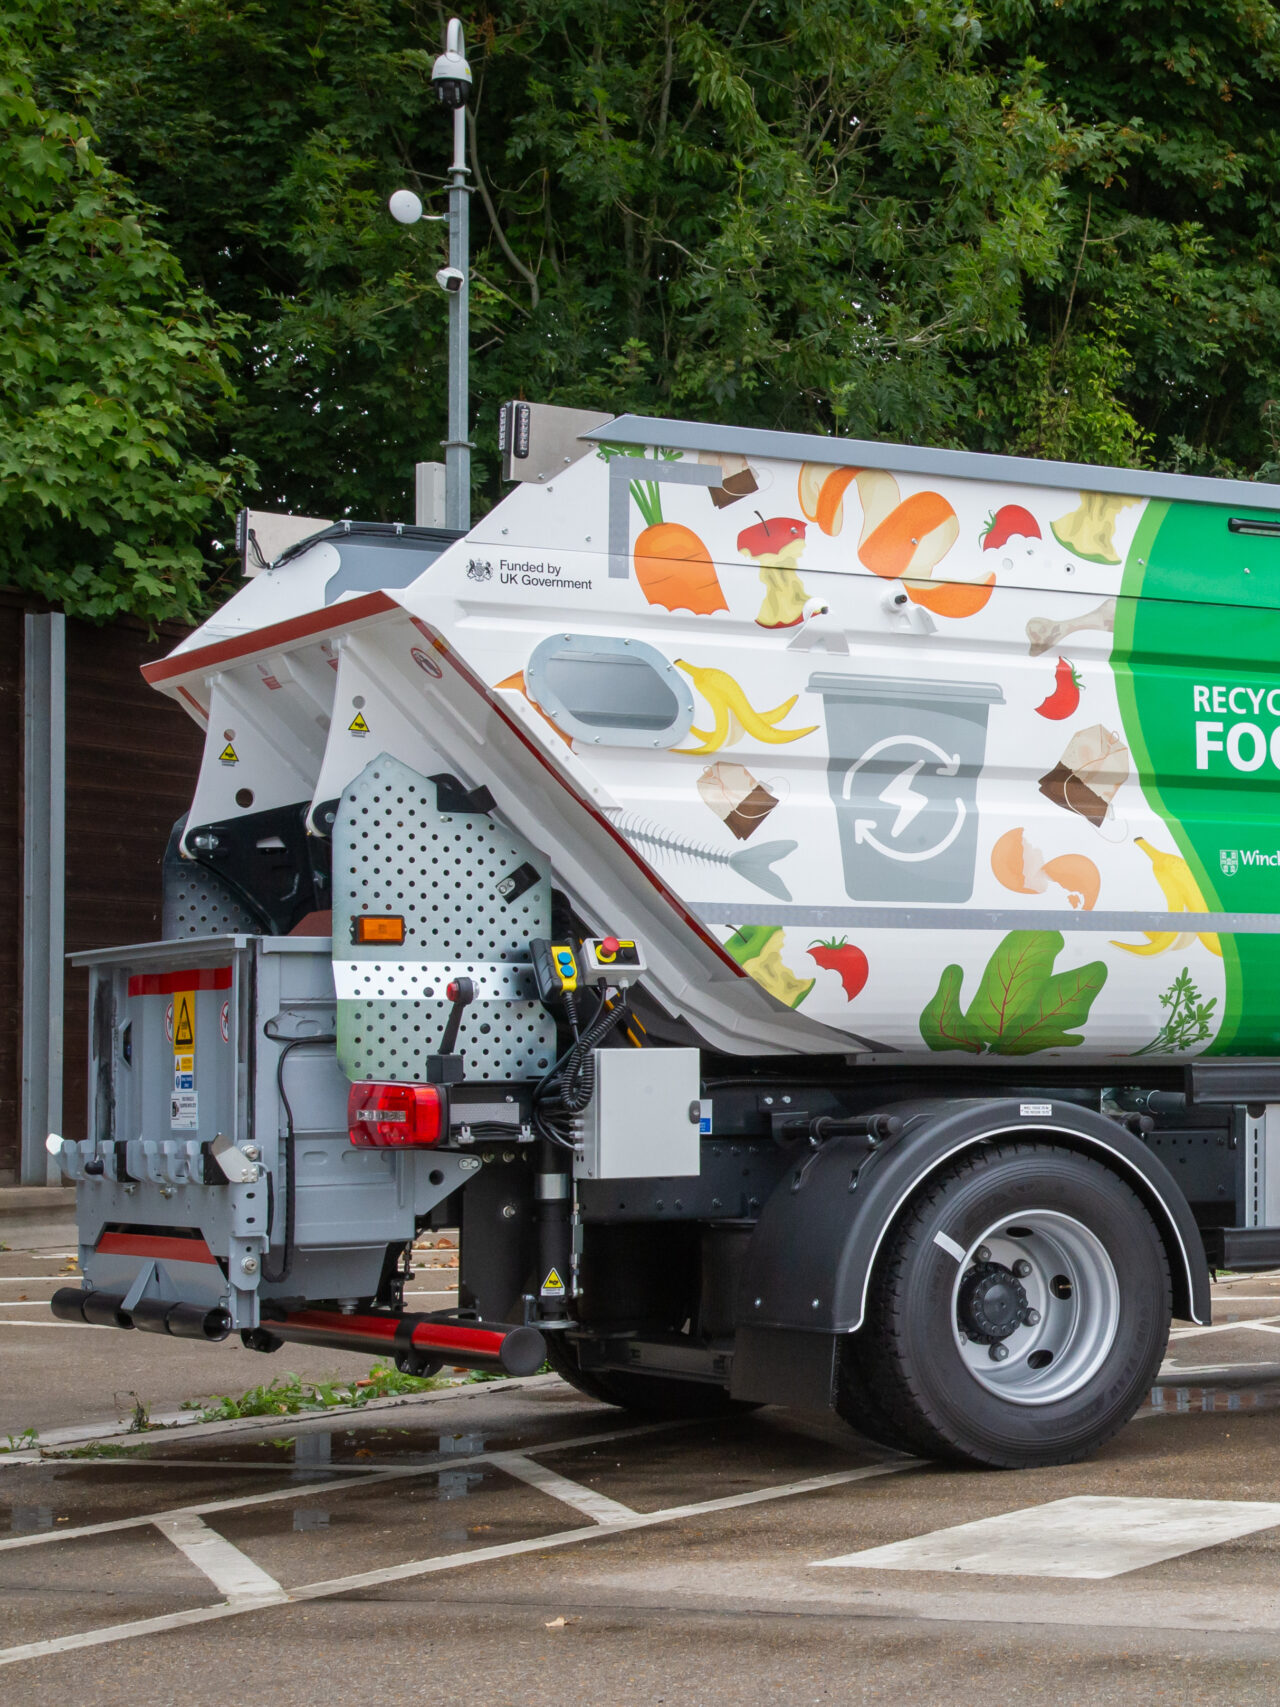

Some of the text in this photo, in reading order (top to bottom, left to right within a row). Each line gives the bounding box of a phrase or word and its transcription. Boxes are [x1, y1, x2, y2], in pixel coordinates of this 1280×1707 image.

[500, 559, 562, 577] Funded by
[500, 573, 593, 590] UK Government
